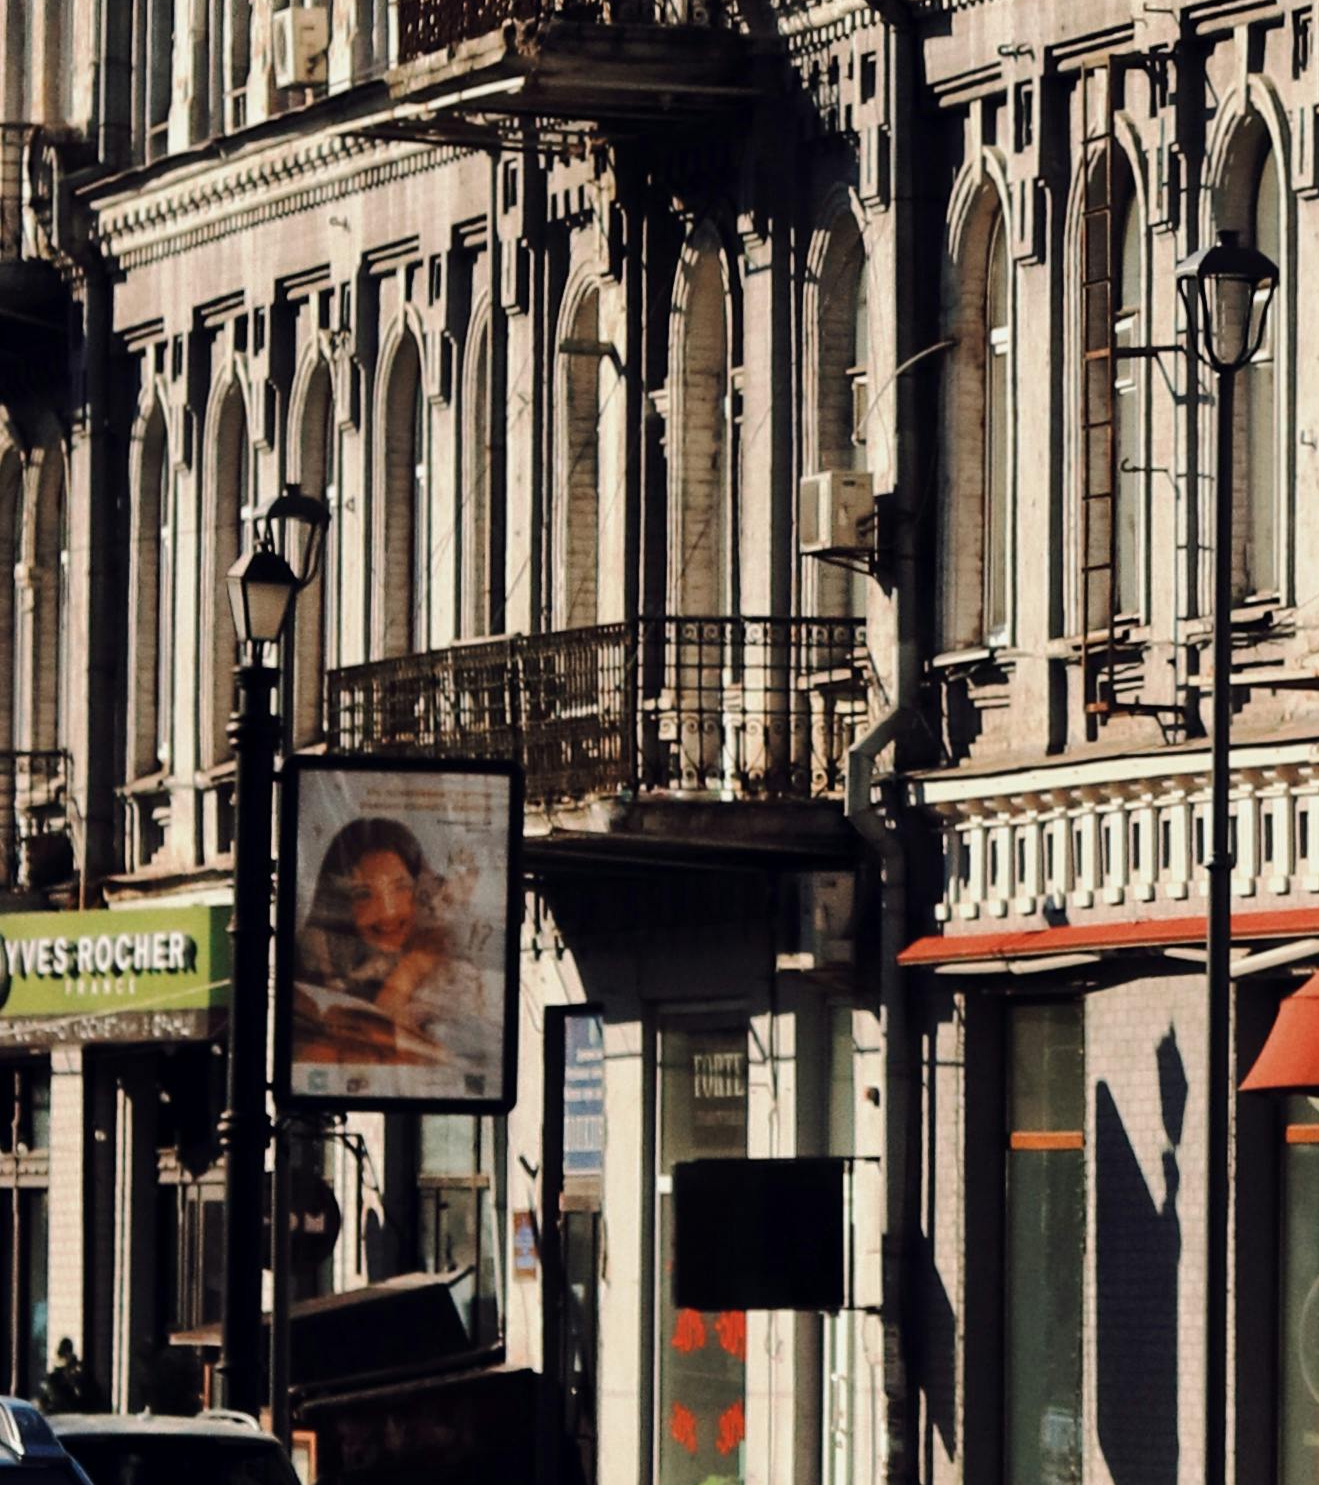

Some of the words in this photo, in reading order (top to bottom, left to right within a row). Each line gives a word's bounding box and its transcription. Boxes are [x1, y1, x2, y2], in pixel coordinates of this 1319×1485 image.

[5, 935, 68, 976] YVES
[77, 931, 185, 972] ROCHER
[64, 978, 136, 996] FRANCE
[694, 1053, 745, 1098] FORTE
